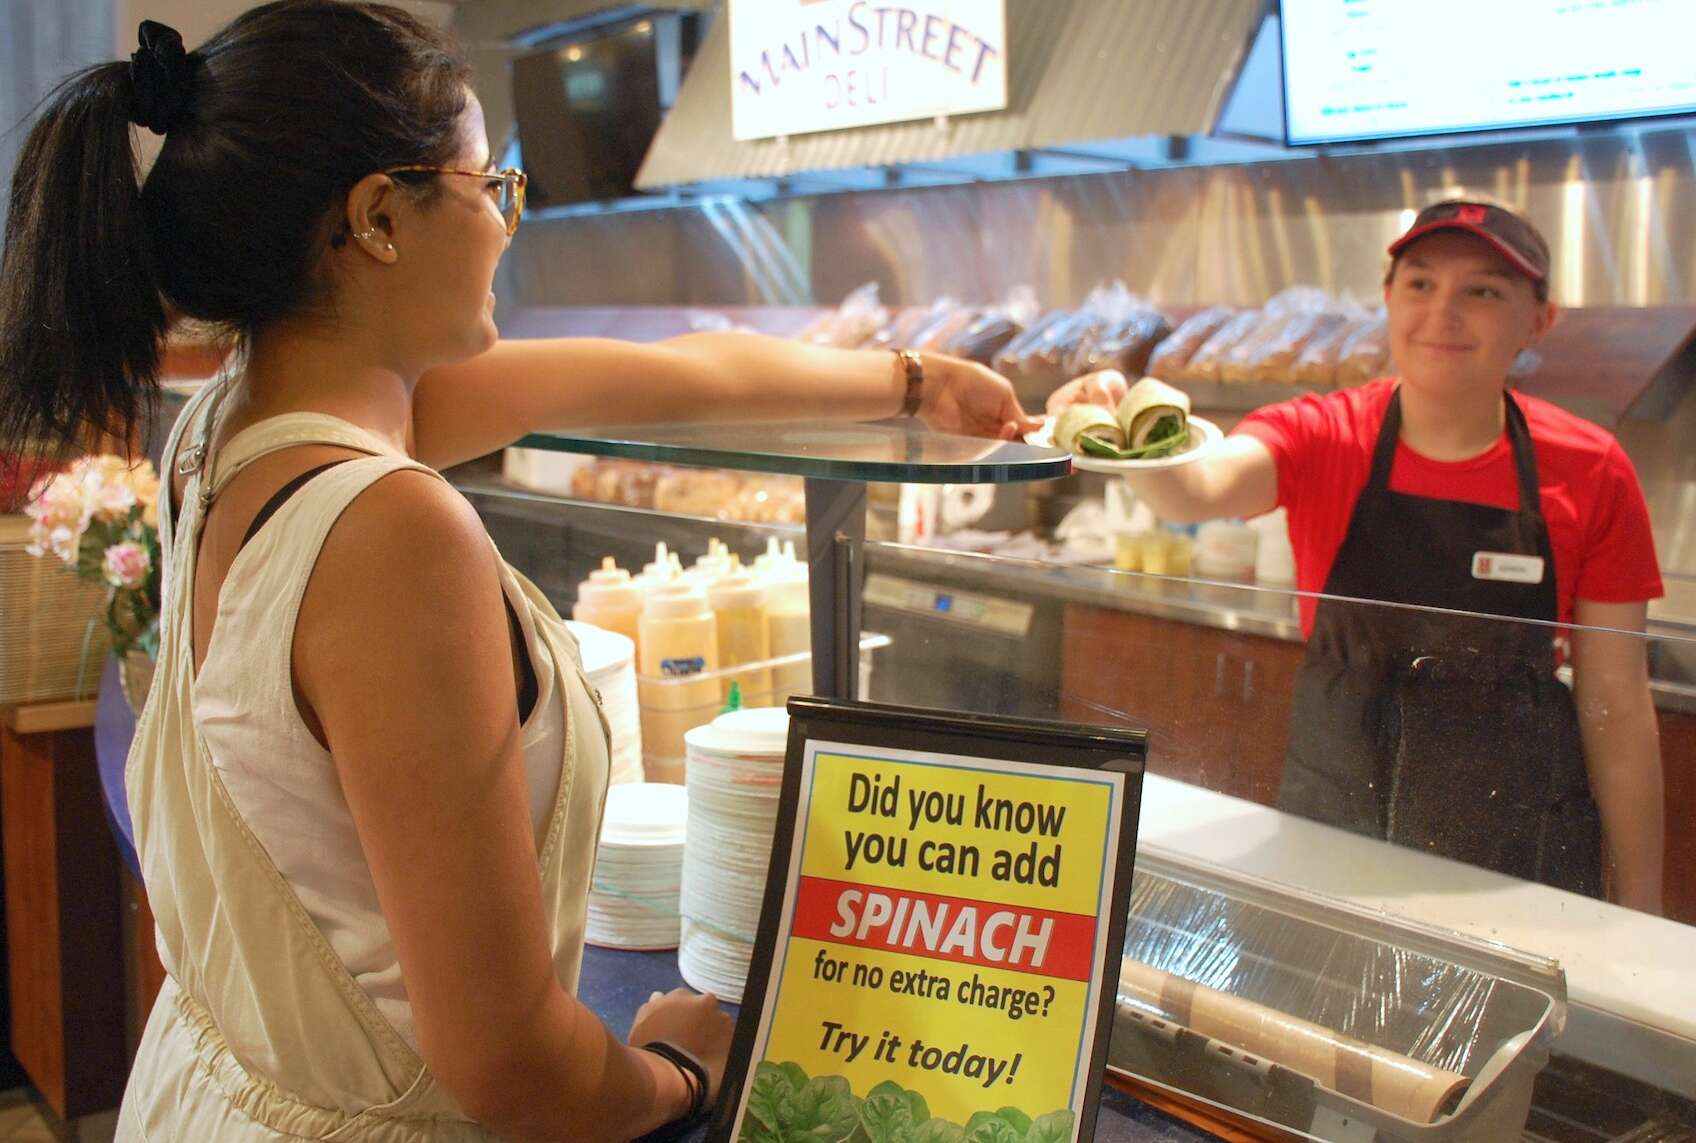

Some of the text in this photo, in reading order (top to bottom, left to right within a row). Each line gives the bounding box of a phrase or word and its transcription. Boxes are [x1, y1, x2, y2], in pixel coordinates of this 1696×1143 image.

[847, 772, 1066, 838] Did you know
[844, 830, 1062, 888] you can add
[829, 889, 1054, 968] SPINACH
[813, 949, 1056, 1020] for no extra charge?
[818, 1021, 1023, 1089] Try it today!
